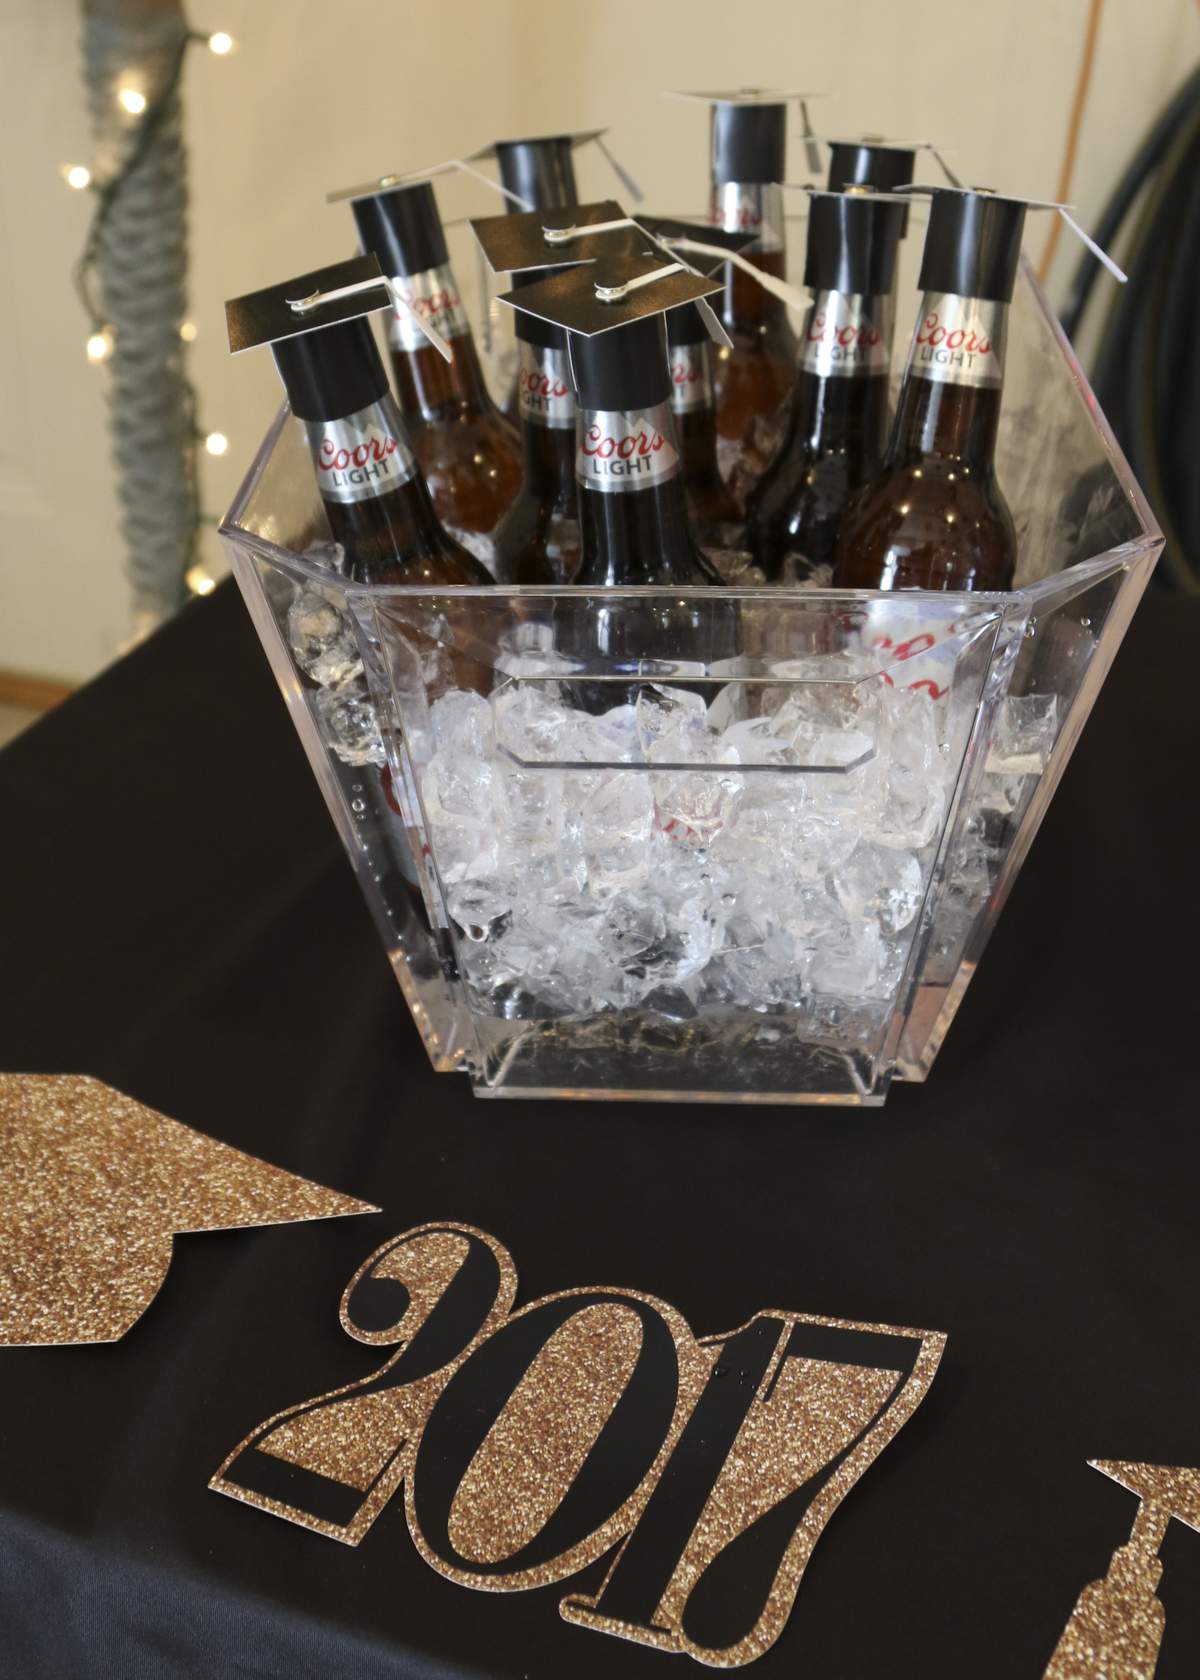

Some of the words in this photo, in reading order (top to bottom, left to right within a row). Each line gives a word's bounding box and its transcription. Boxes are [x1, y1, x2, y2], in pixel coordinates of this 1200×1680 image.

[916, 312, 993, 354] Coors
[920, 346, 977, 369] LIGHT
[520, 367, 569, 397] oors
[318, 437, 398, 471] Coors
[580, 424, 666, 460] Coors
[332, 458, 390, 487] LIGHT
[592, 454, 653, 476] LIGHT
[207, 1221, 949, 1669] 2017
